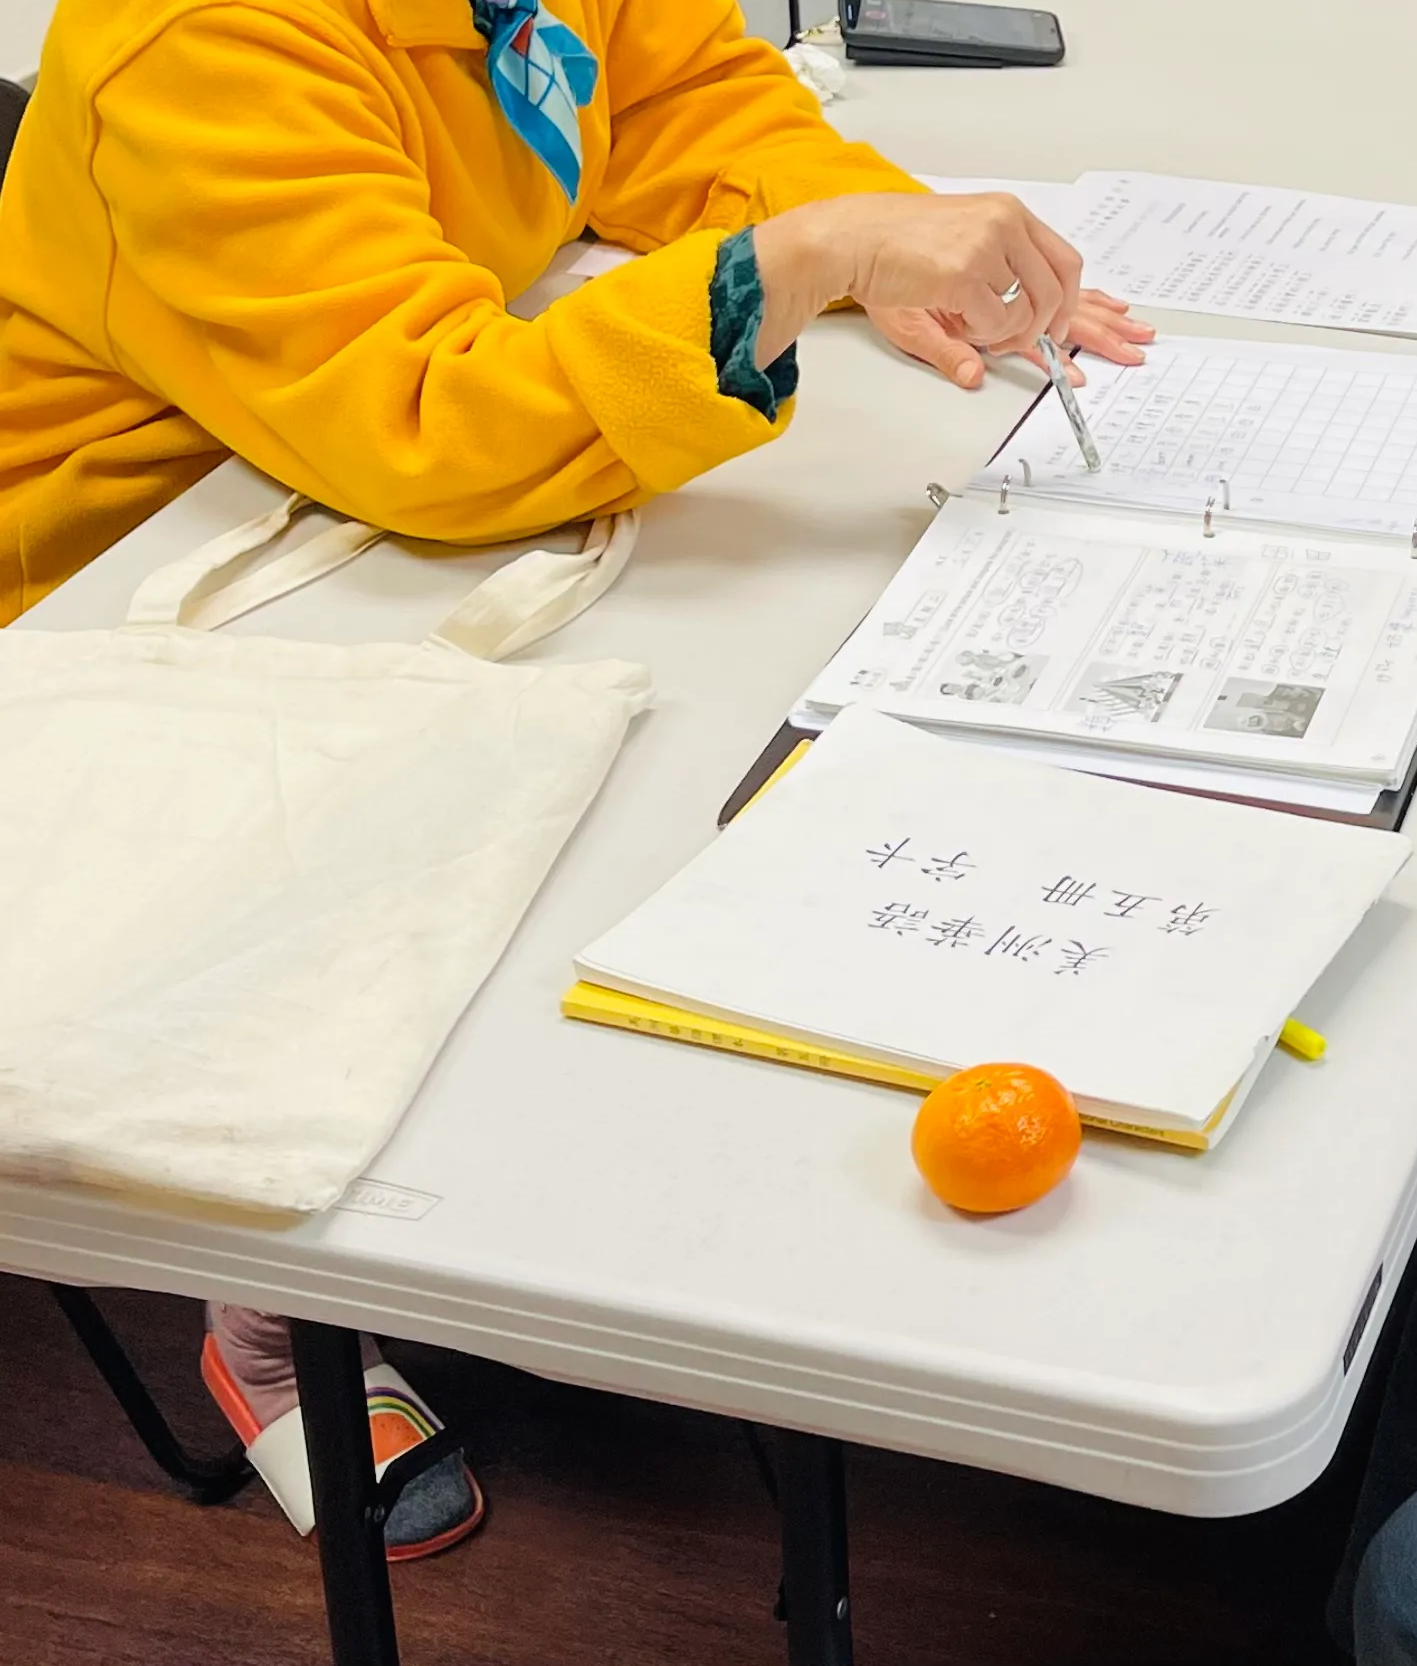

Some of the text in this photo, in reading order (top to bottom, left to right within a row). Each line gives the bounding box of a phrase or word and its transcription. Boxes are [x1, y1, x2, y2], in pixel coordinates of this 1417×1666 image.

[866, 837, 978, 882] 字卡
[868, 902, 1116, 975] 美洲華語
